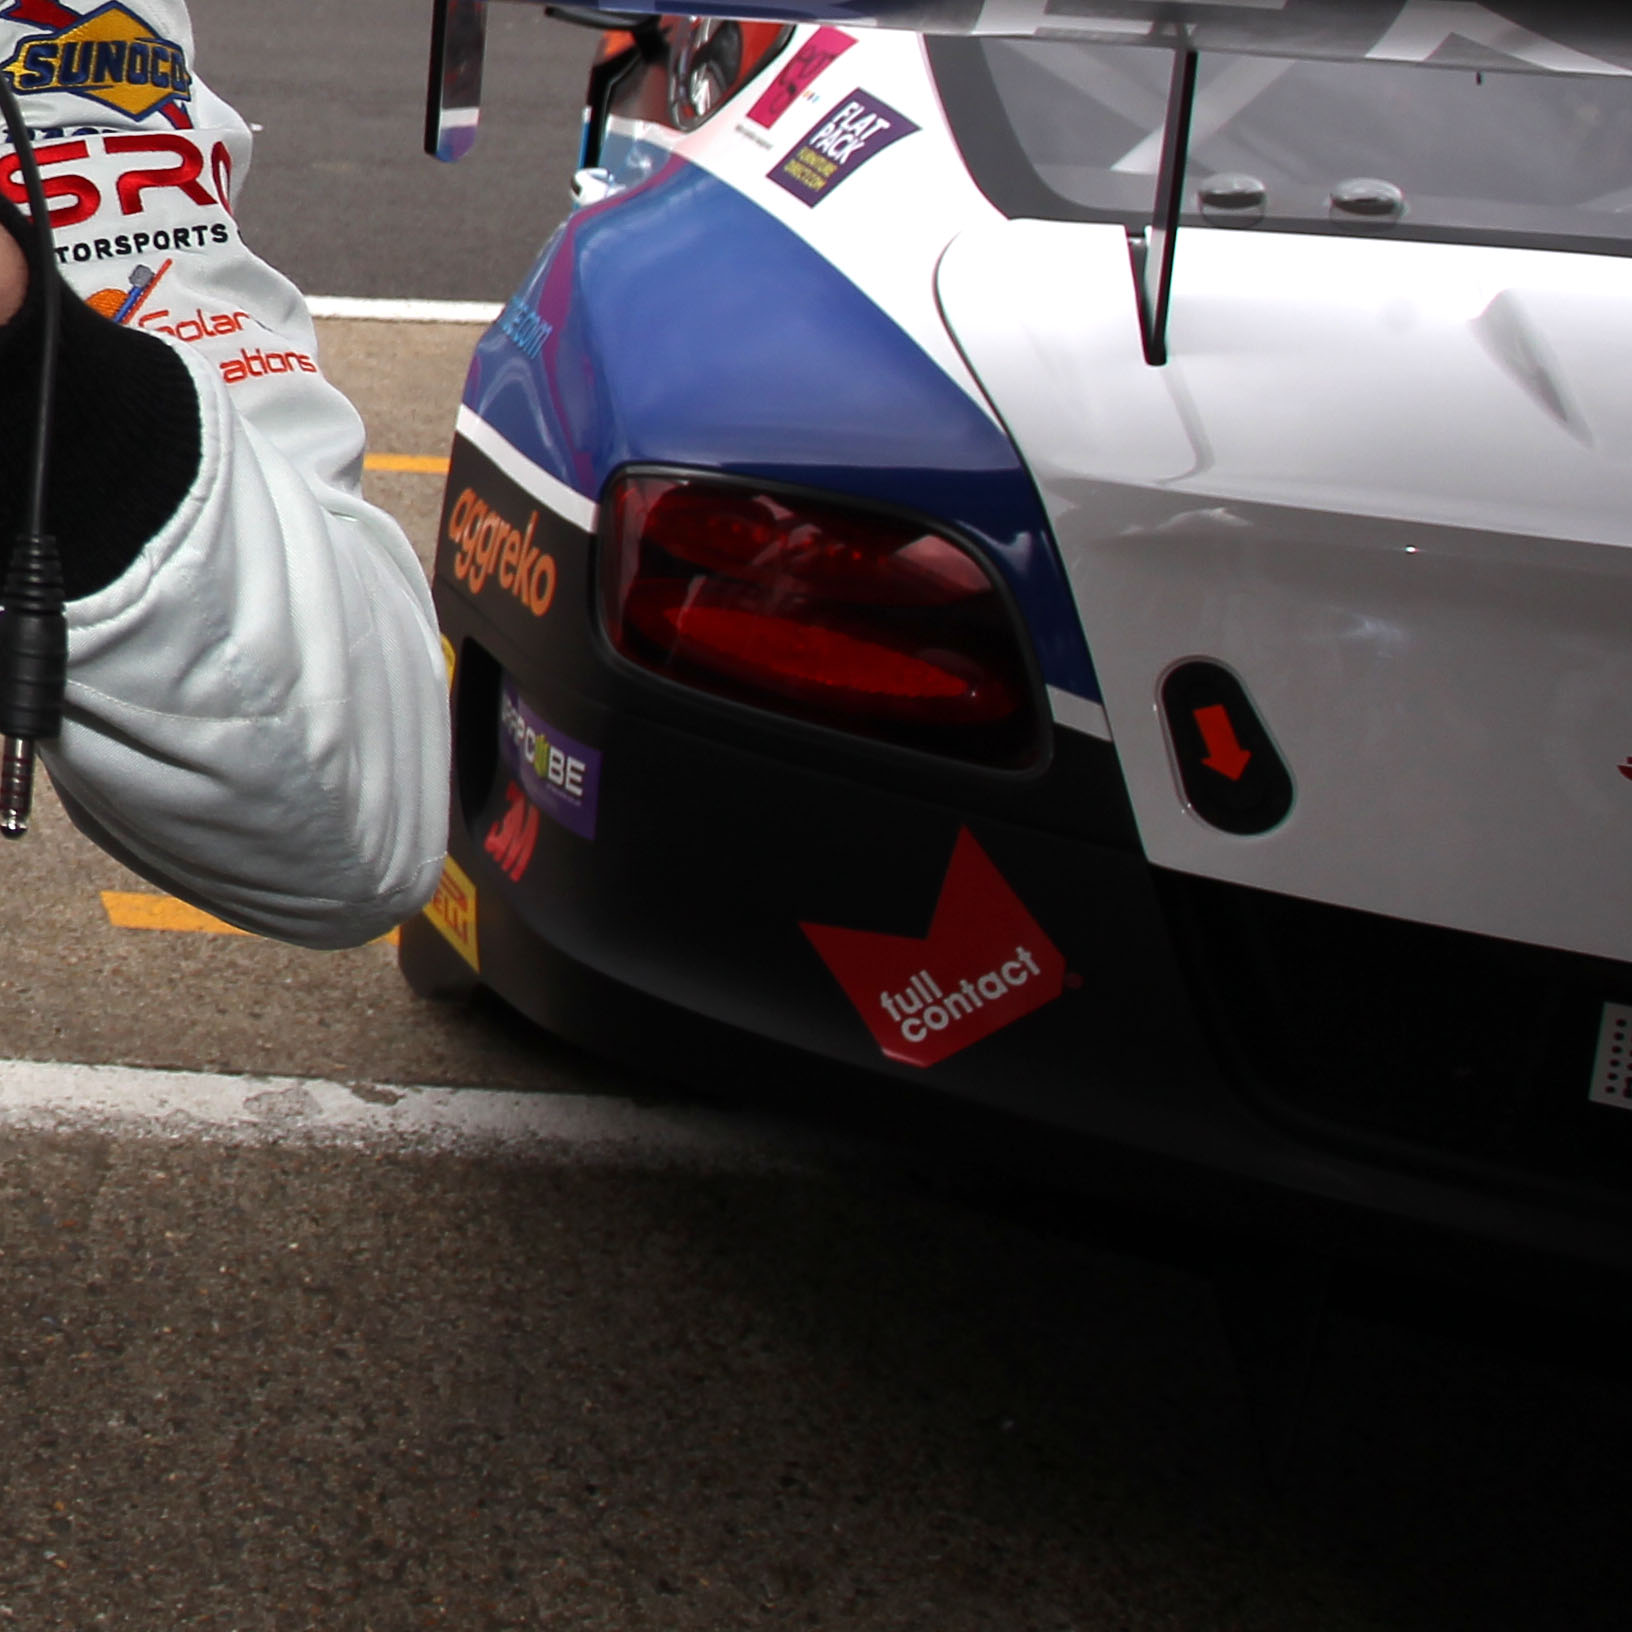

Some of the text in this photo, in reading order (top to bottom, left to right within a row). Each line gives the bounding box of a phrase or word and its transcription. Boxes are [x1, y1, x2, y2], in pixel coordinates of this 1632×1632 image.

[20, 40, 192, 92] SUNOCO
[810, 121, 865, 165] PACK
[835, 101, 891, 140] FLAT
[55, 223, 229, 264] TORSPORTS
[219, 348, 317, 384] ations
[448, 487, 558, 617] aggreko
[484, 779, 541, 884] 3M
[880, 969, 943, 1022] full
[900, 946, 1041, 1043] contact
